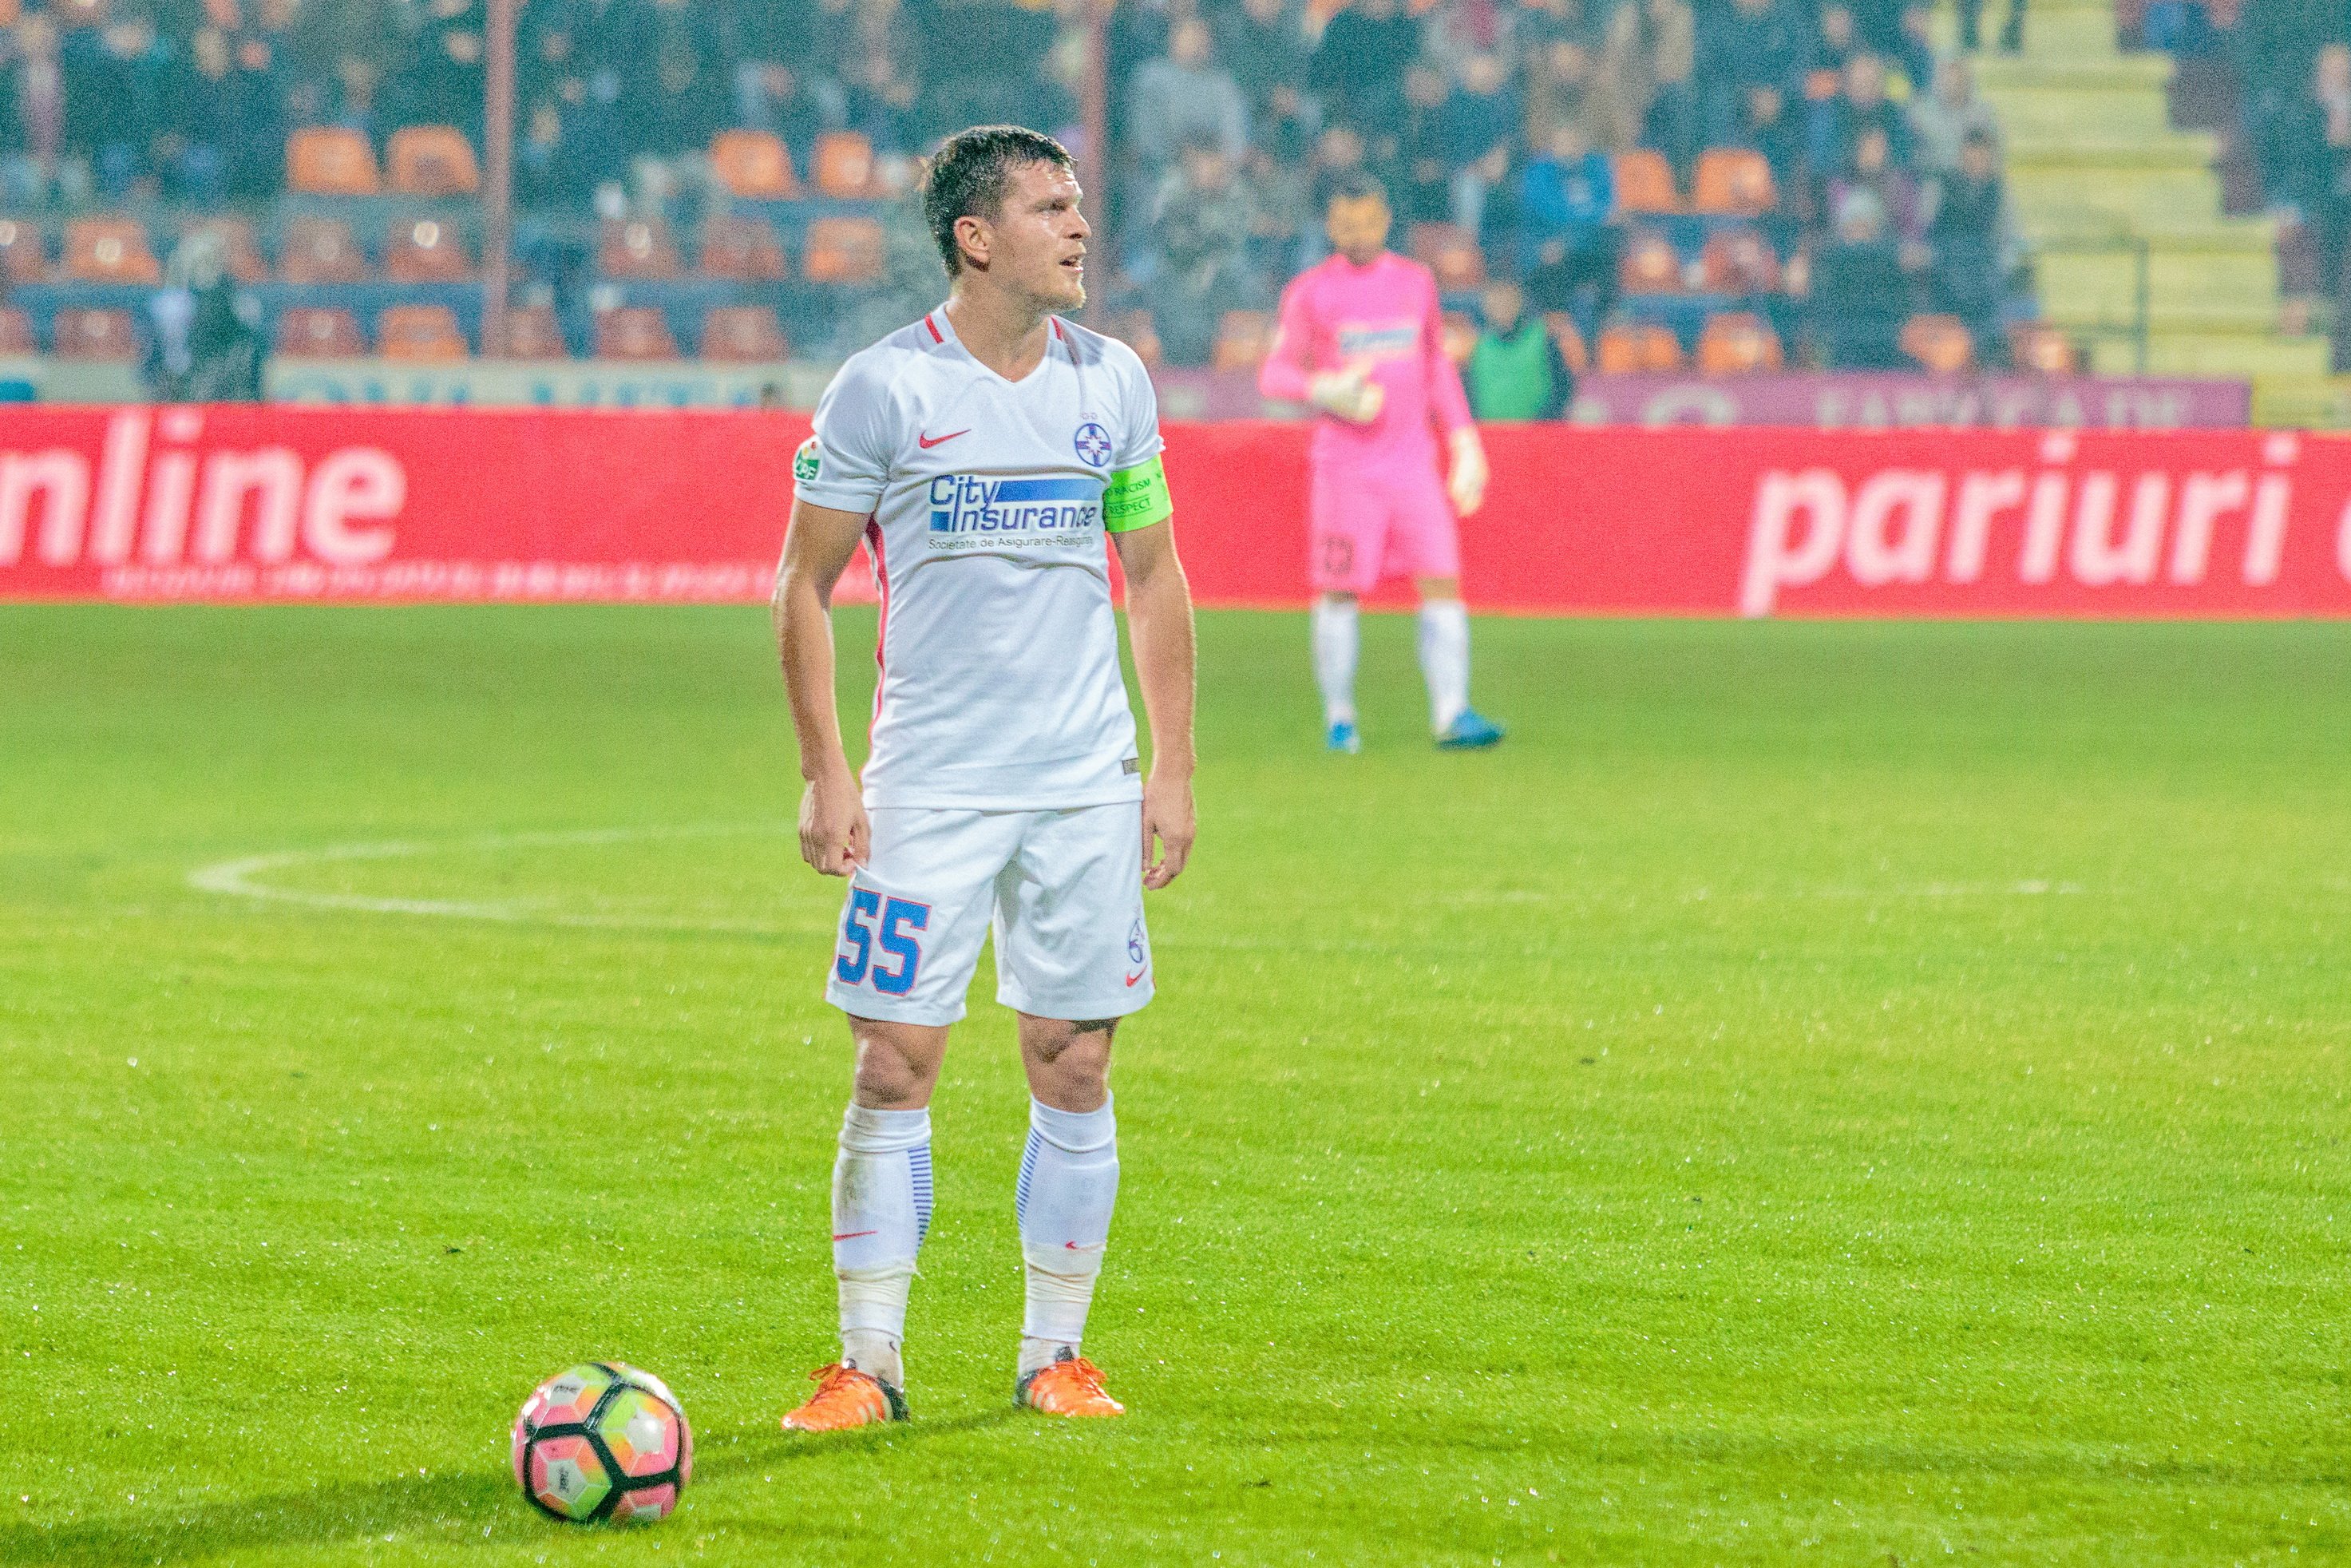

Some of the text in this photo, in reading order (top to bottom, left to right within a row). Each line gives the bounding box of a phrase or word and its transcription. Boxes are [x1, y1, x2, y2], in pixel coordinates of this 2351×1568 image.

[930, 474, 999, 512] City
[1110, 497, 1150, 514] RESPECT
[951, 505, 1098, 533] Insurance
[1740, 431, 2299, 618] pariuri
[928, 538, 976, 550] Societate
[980, 539, 995, 548] de
[837, 886, 932, 997] 55
